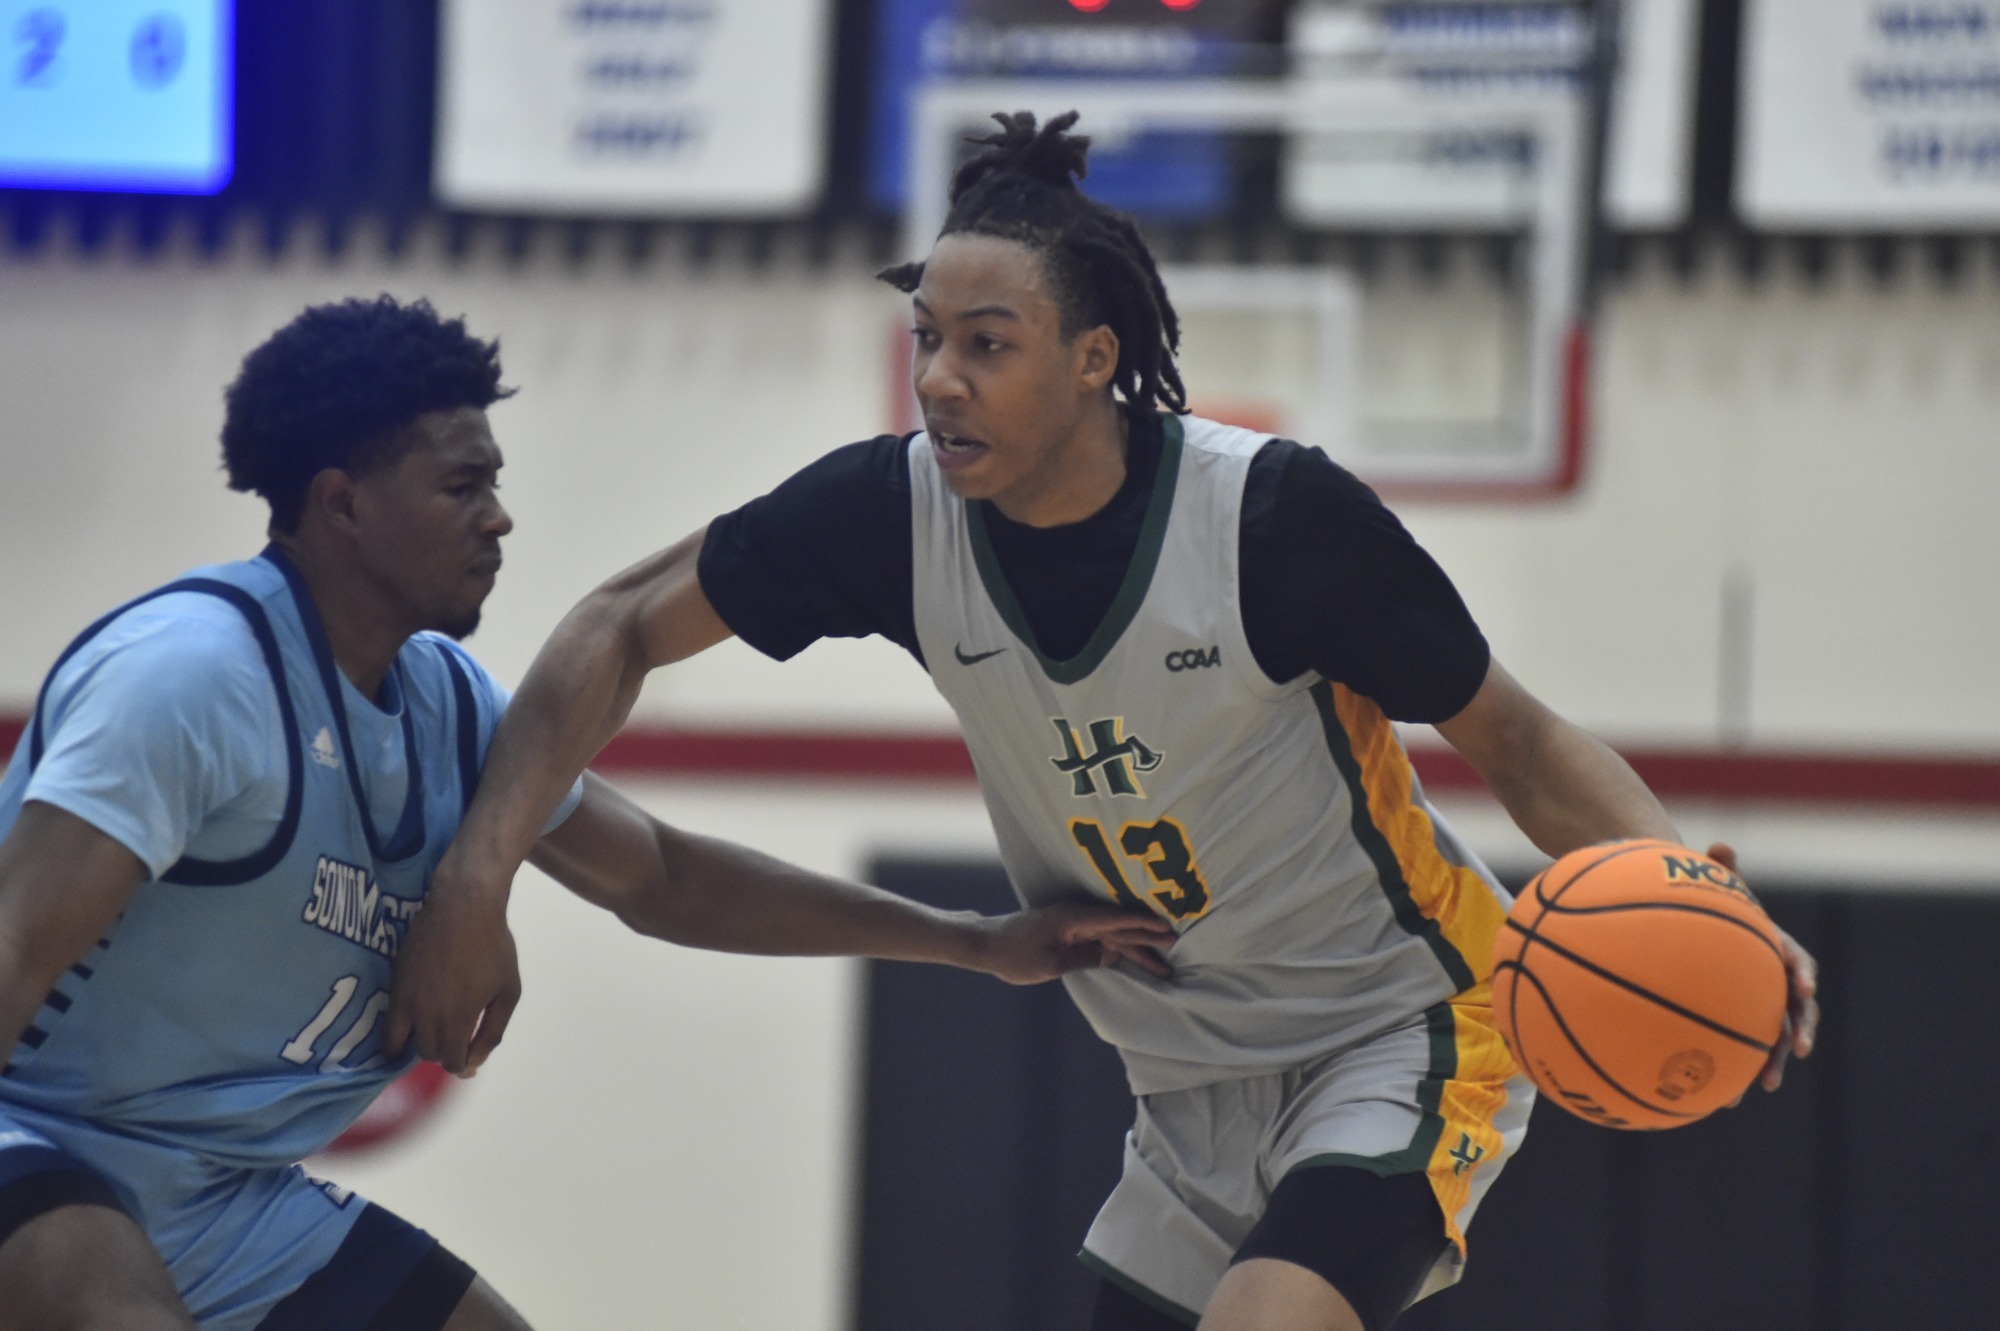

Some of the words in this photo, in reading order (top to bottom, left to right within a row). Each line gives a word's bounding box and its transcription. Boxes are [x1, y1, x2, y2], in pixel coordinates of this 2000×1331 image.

[301, 854, 390, 956] SONOMA
[1067, 815, 1212, 922] 13
[1660, 854, 1755, 896] NC
